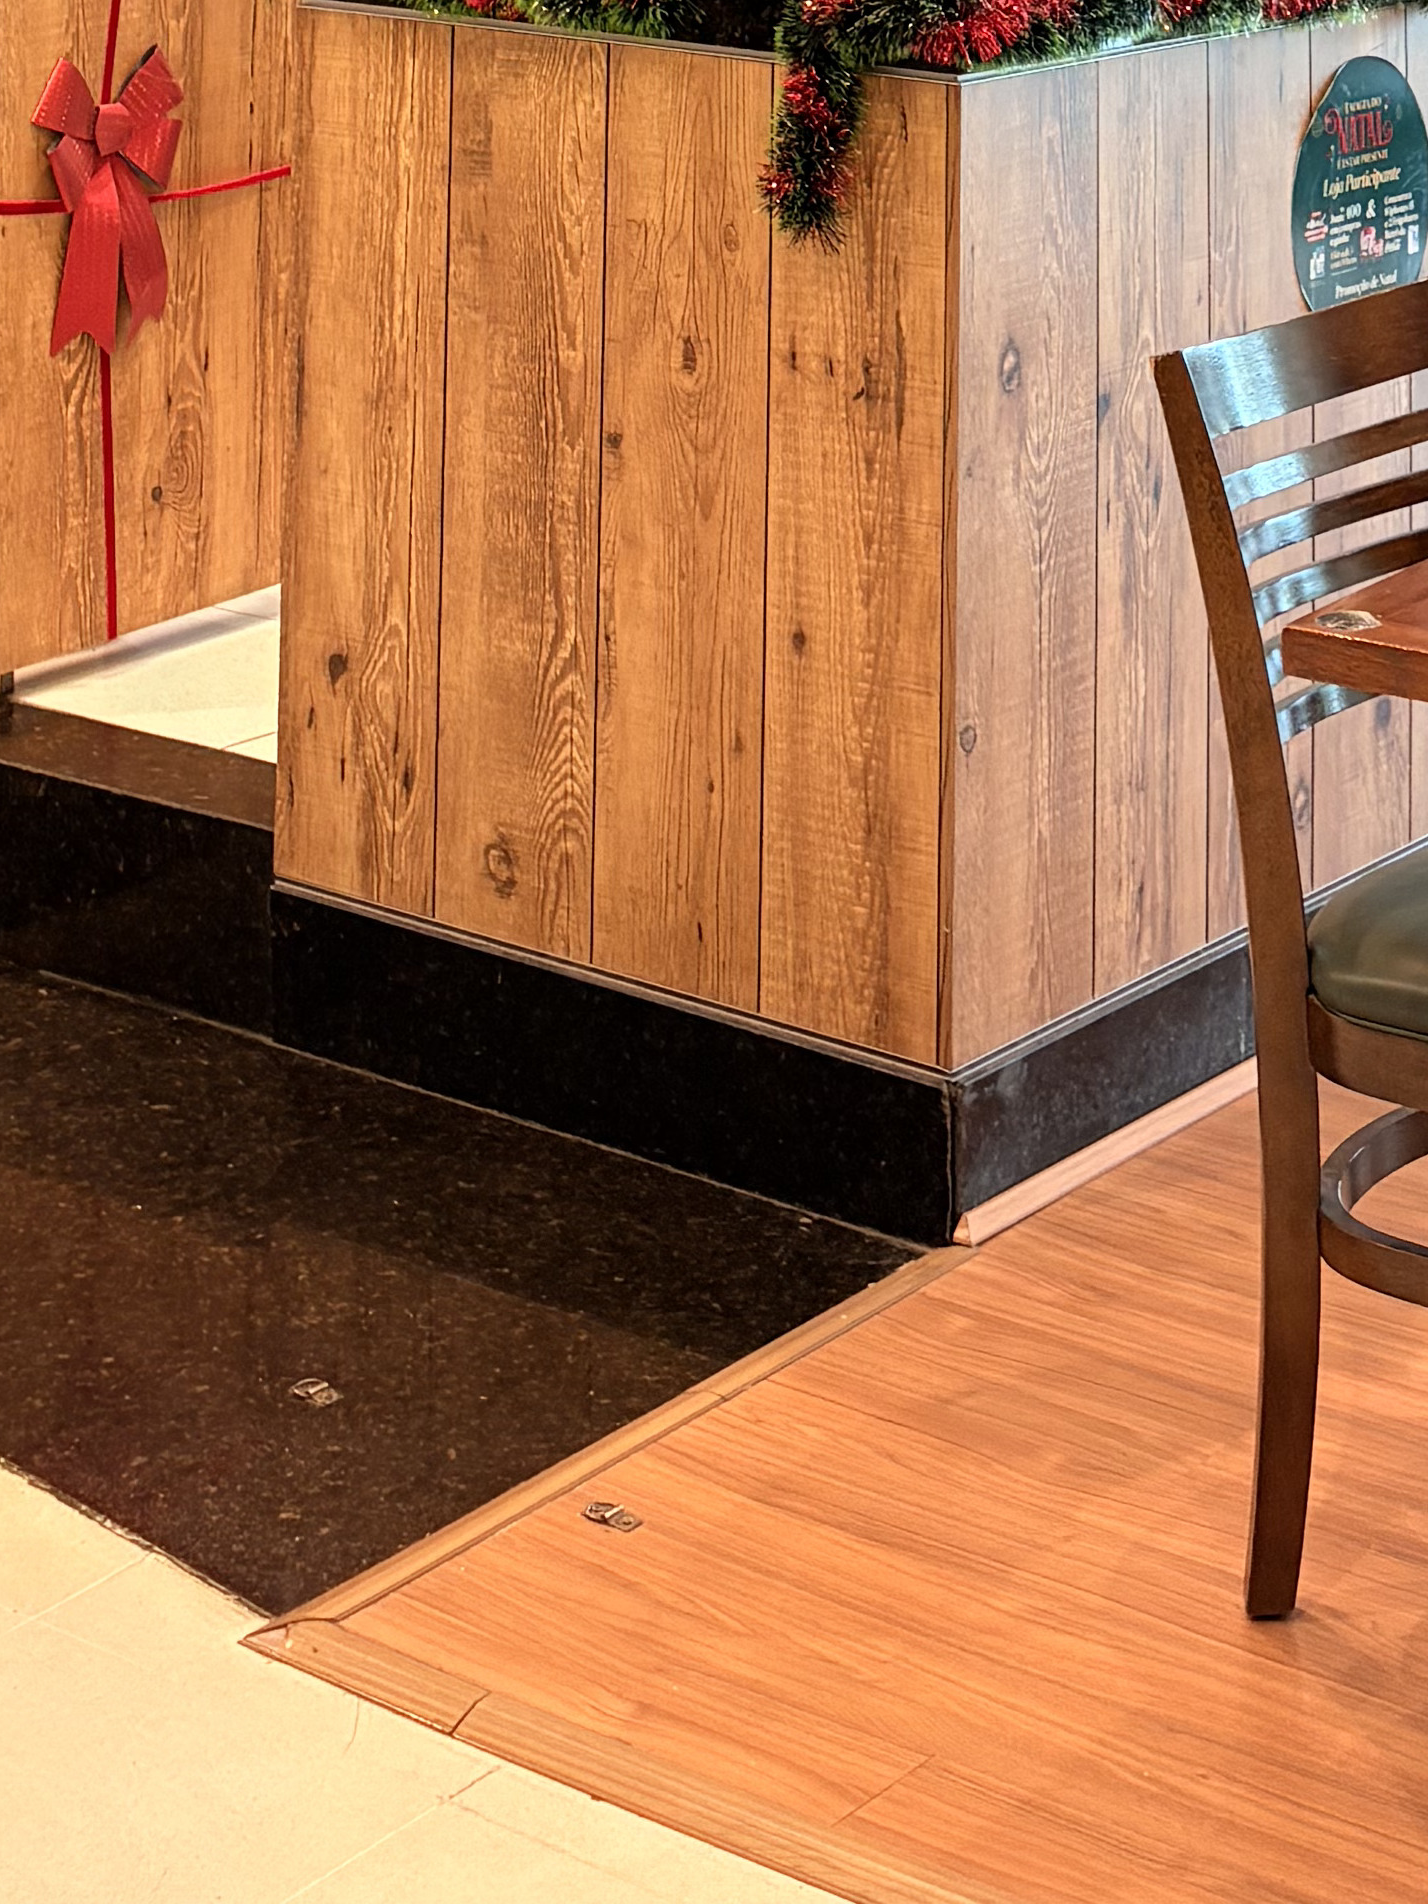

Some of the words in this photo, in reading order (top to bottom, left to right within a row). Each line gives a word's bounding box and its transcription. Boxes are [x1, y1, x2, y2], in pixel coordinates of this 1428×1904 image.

[1324, 108, 1394, 155] NATAL
[1322, 177, 1345, 200] Loja
[1345, 167, 1402, 192] Participante
